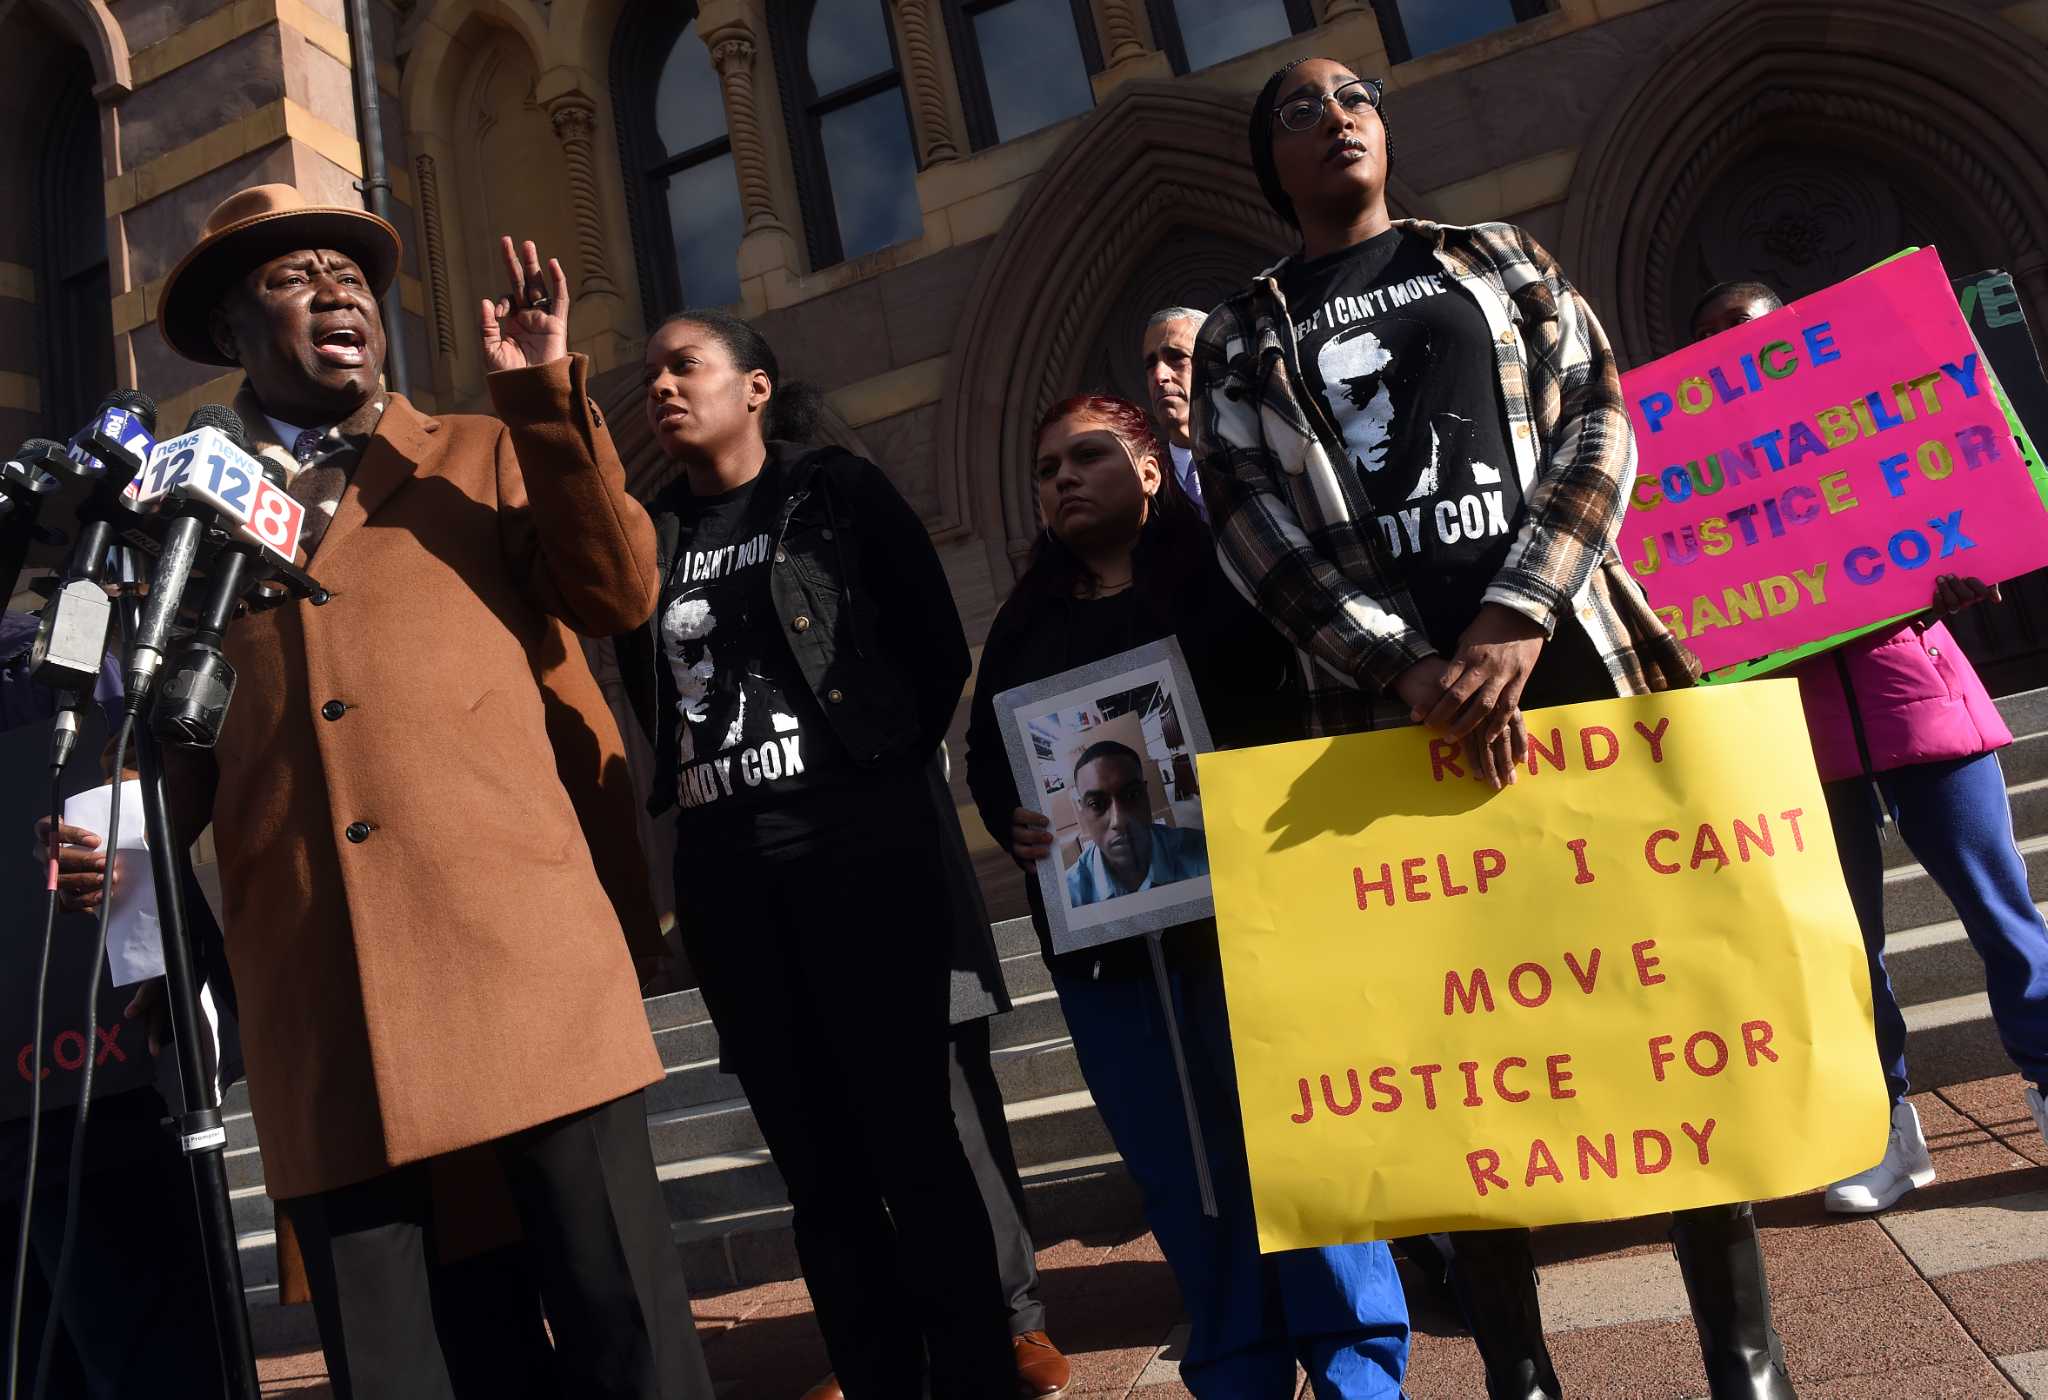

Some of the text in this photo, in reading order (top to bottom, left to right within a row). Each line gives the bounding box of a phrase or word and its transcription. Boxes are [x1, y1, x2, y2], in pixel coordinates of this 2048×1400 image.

[1324, 301, 1335, 328] I
[1334, 289, 1388, 325] CAN'T
[1639, 321, 1842, 433] POLICE
[156, 433, 200, 458] news
[211, 437, 256, 476] news
[1628, 353, 1979, 512] COUNTABILITY
[150, 448, 195, 494] 12
[207, 454, 251, 514] 12
[1632, 424, 2000, 576] JUSTICE FOR
[254, 489, 292, 546] 8
[1434, 490, 1509, 544] COX
[682, 551, 691, 583] I
[691, 545, 735, 580] CAN'T
[734, 533, 772, 572] MOV
[1653, 509, 1978, 640] RANDY COX
[679, 735, 805, 809] ANDY COX
[1429, 717, 1670, 782] RNDY
[1353, 807, 1805, 911] HELP I CANT
[1443, 939, 1666, 1016] MOVE
[17, 1022, 128, 1083] COX
[1289, 1020, 1779, 1124] JUSTICE FOR
[1465, 1117, 1717, 1197] RANDY
